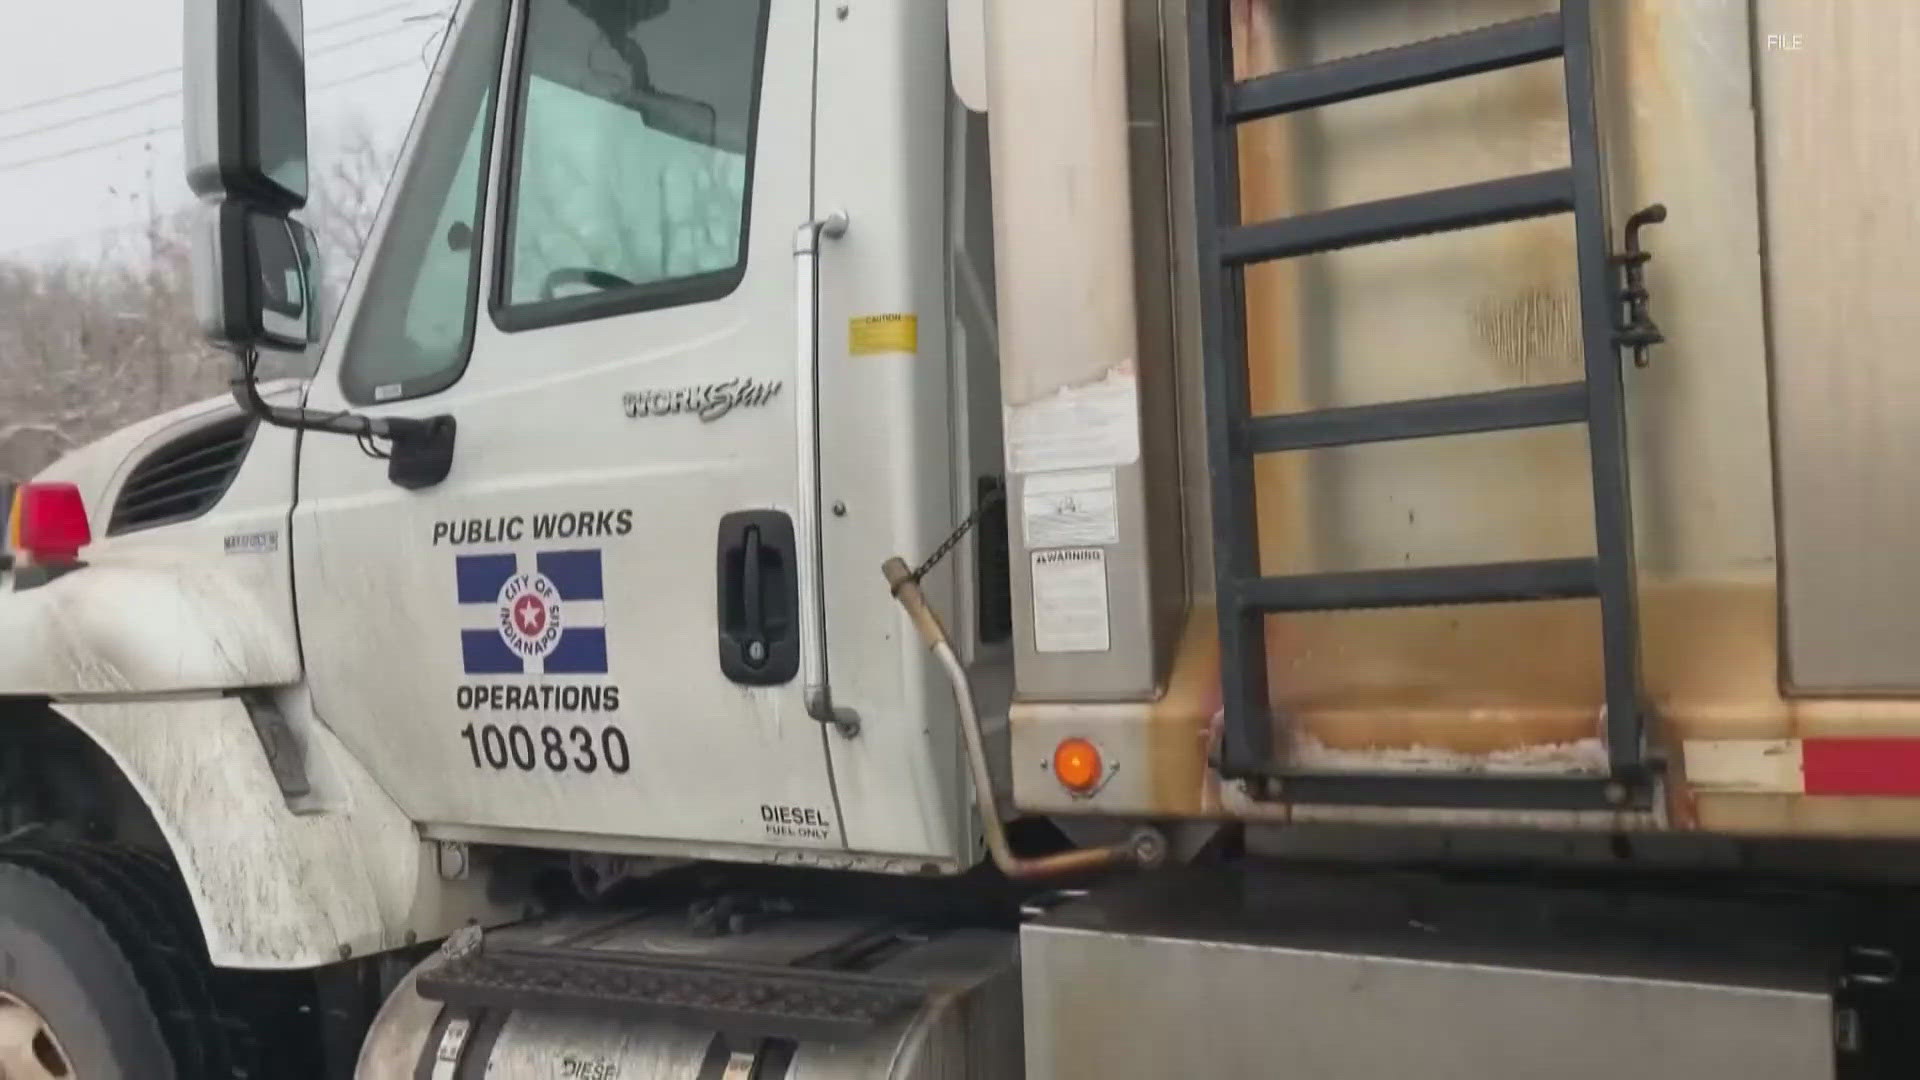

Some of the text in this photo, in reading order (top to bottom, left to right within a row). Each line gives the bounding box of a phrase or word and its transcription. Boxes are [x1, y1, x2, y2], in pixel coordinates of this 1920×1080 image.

[433, 509, 633, 546] PUBLIC WORKS
[505, 574, 553, 601] CITY OF
[500, 605, 560, 656] INDIANAPOLIS
[456, 685, 620, 712] OPERATIONS
[461, 722, 630, 774] 100830
[761, 805, 830, 826] DIESEL
[766, 824, 829, 840] FUEL ONLY
